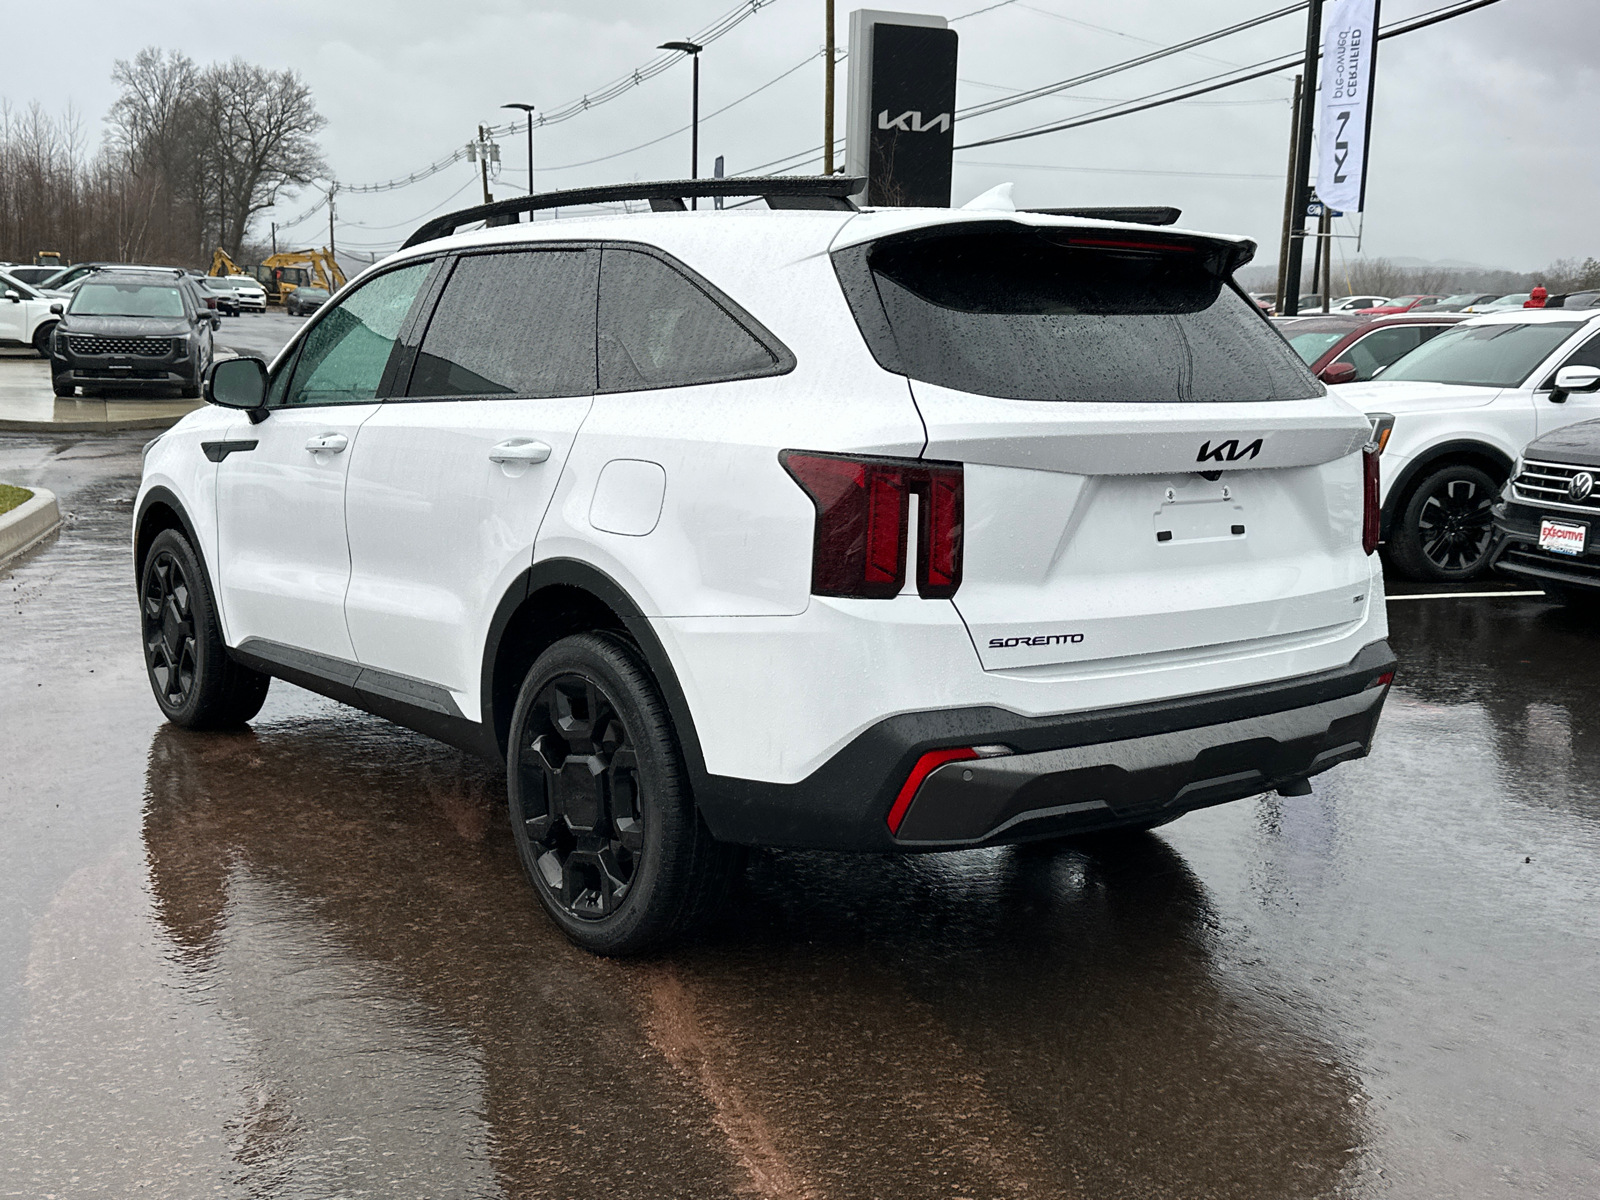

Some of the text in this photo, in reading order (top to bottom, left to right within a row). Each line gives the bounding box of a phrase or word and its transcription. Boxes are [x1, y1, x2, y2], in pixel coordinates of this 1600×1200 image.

[878, 109, 951, 134] KIA
[1196, 438, 1264, 462] KIA
[1542, 526, 1583, 541] EXECUTIVE
[988, 633, 1085, 649] SORENTO
